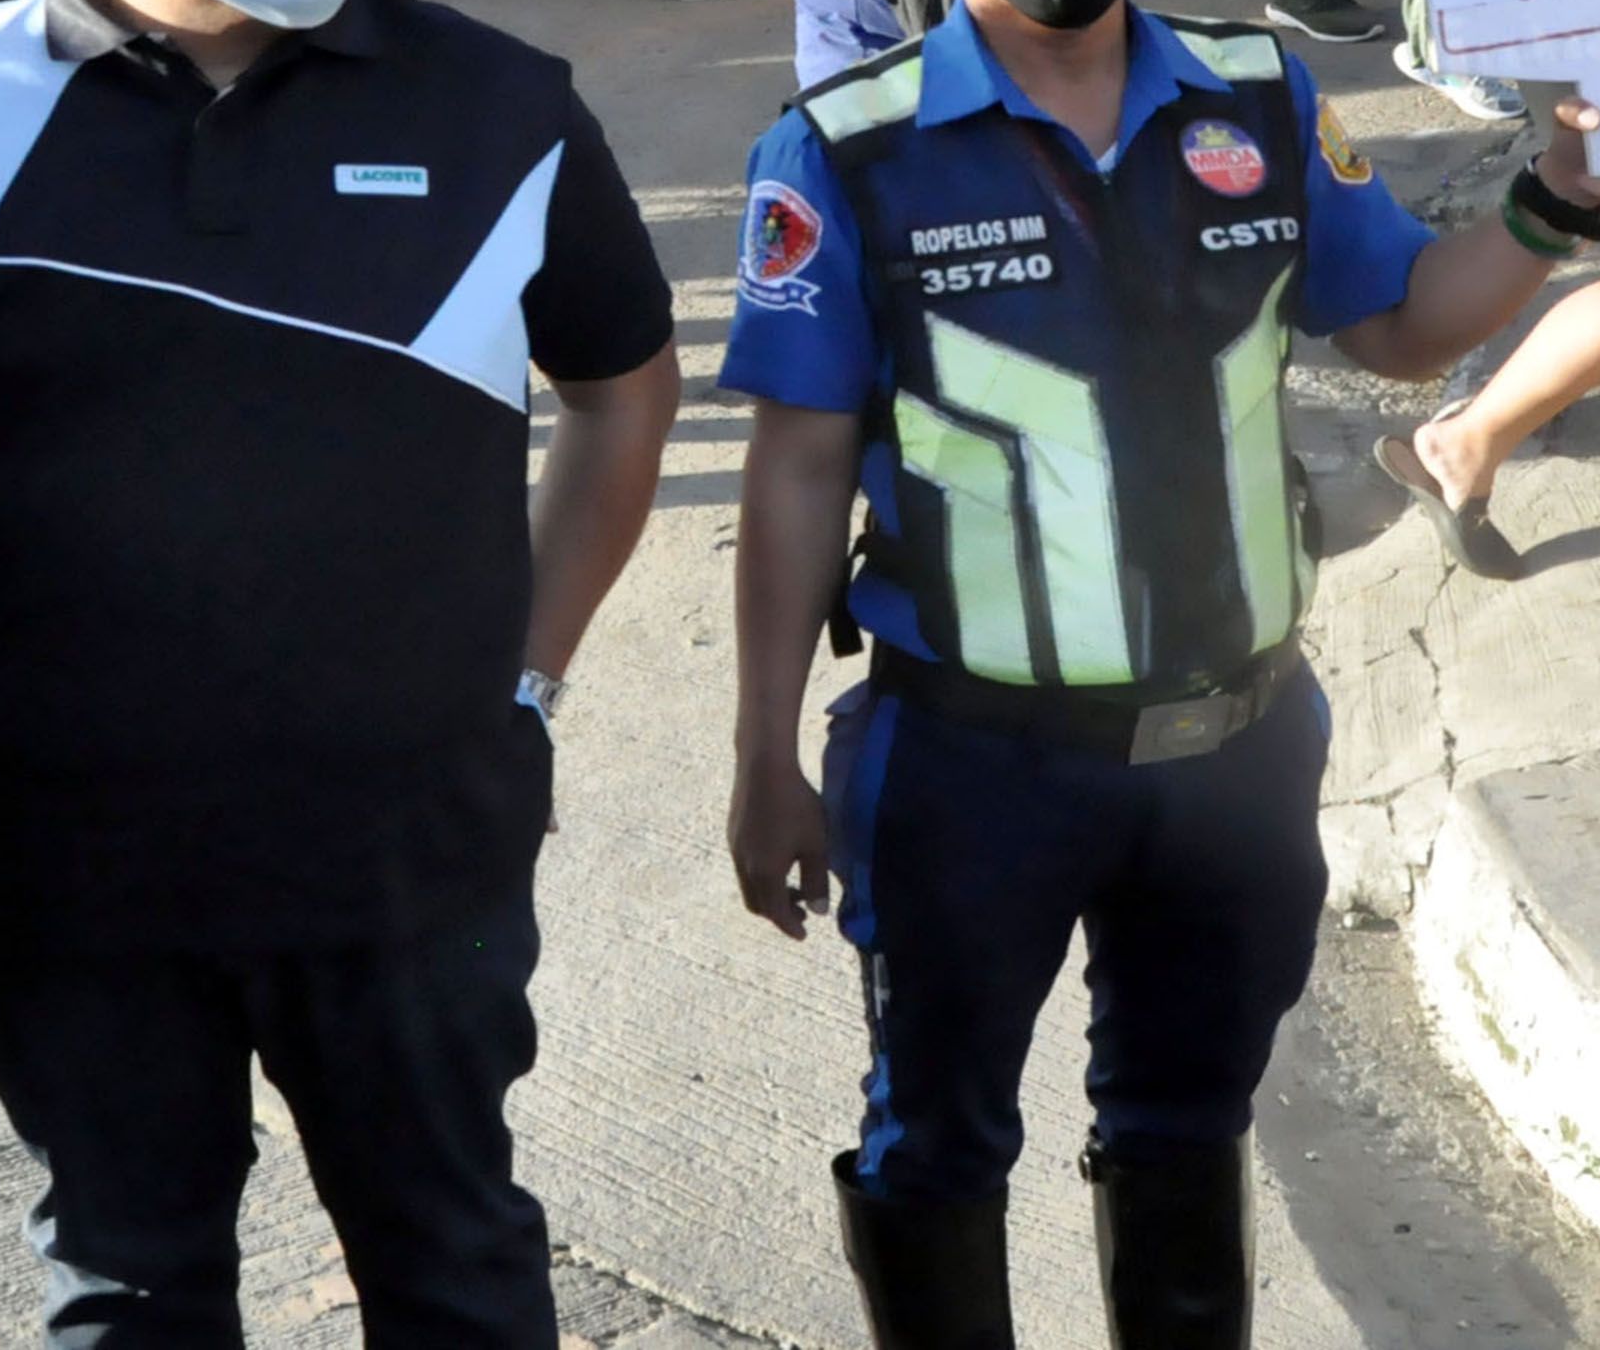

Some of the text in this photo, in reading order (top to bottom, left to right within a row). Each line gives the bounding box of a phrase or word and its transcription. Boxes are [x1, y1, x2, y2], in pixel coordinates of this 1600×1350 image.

[1188, 149, 1260, 168] MMDA
[351, 170, 423, 183] LACOSTE
[911, 215, 1047, 255] ROPELOS MM
[1201, 217, 1299, 250] CSTD
[920, 254, 1053, 295] 35740
